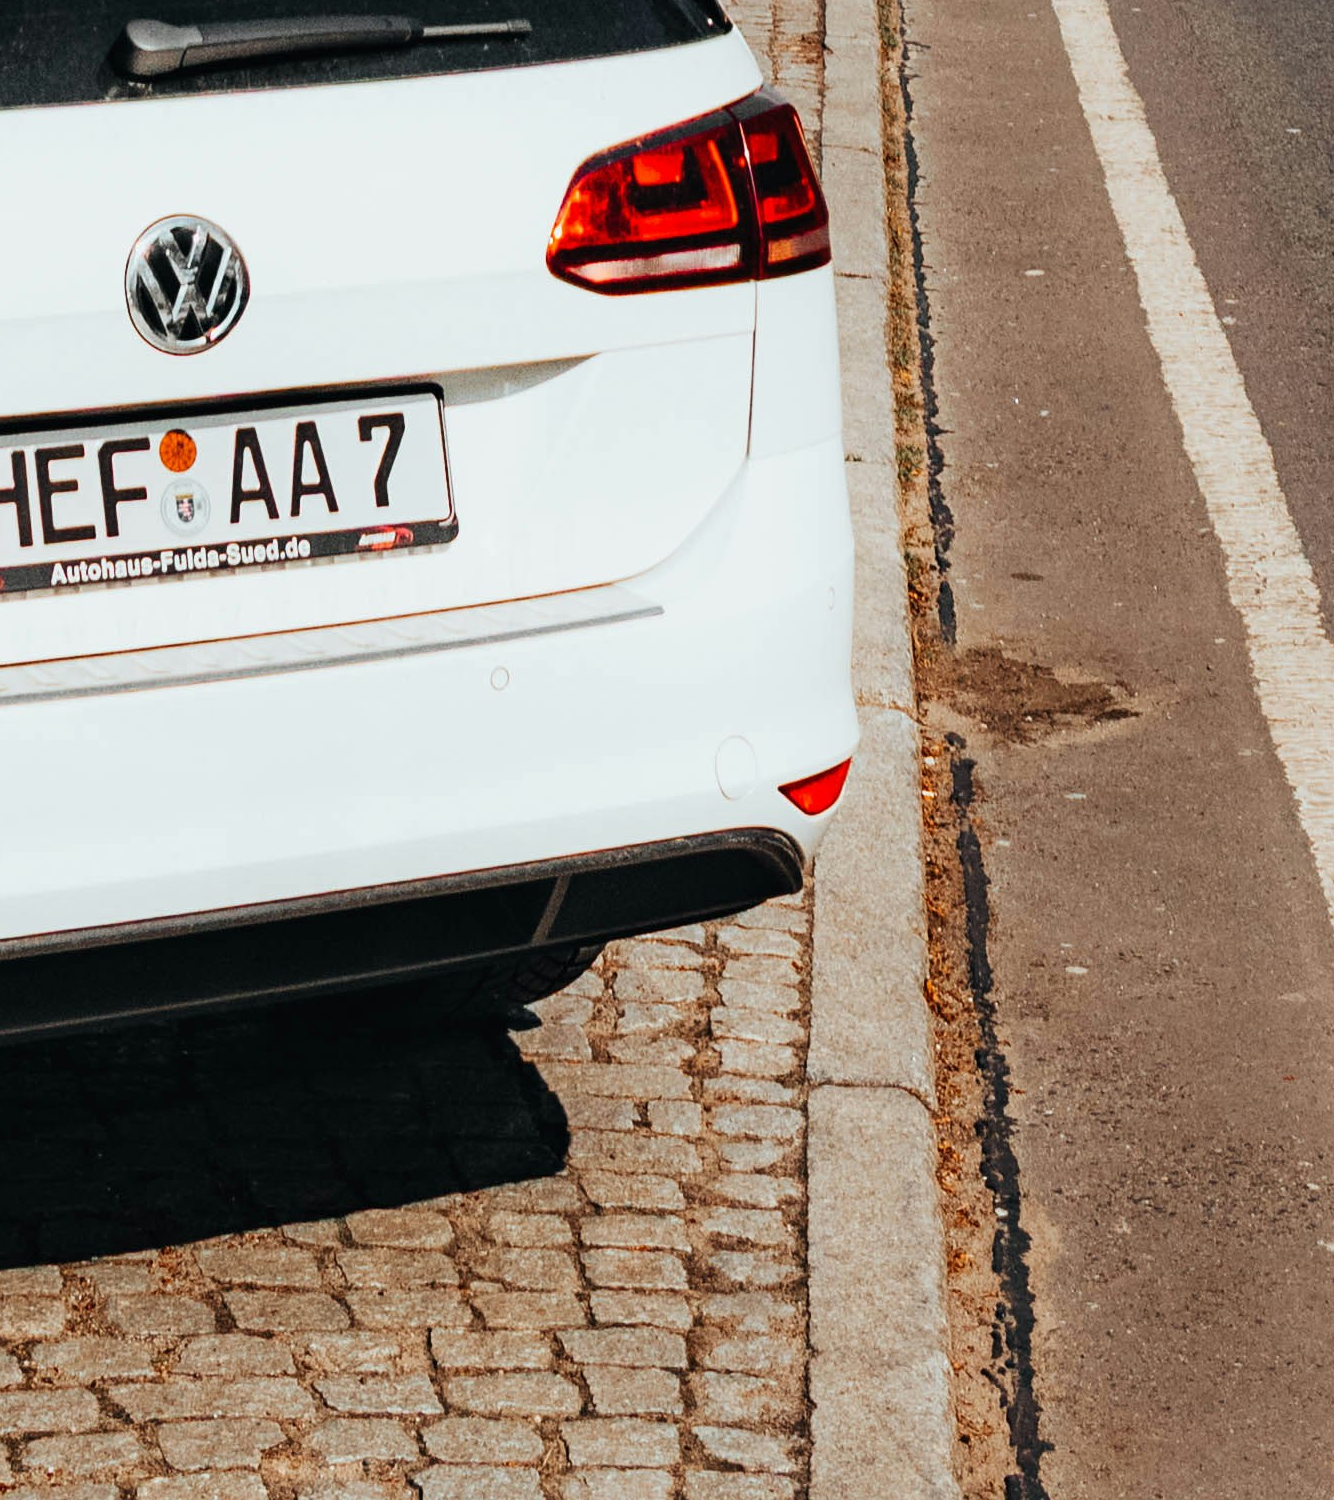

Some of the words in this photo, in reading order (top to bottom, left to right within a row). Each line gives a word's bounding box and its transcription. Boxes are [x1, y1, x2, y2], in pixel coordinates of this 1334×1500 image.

[230, 421, 339, 524] AA
[358, 412, 405, 507] 7
[51, 536, 310, 585] Autohaus-Fulda-Sued.de
